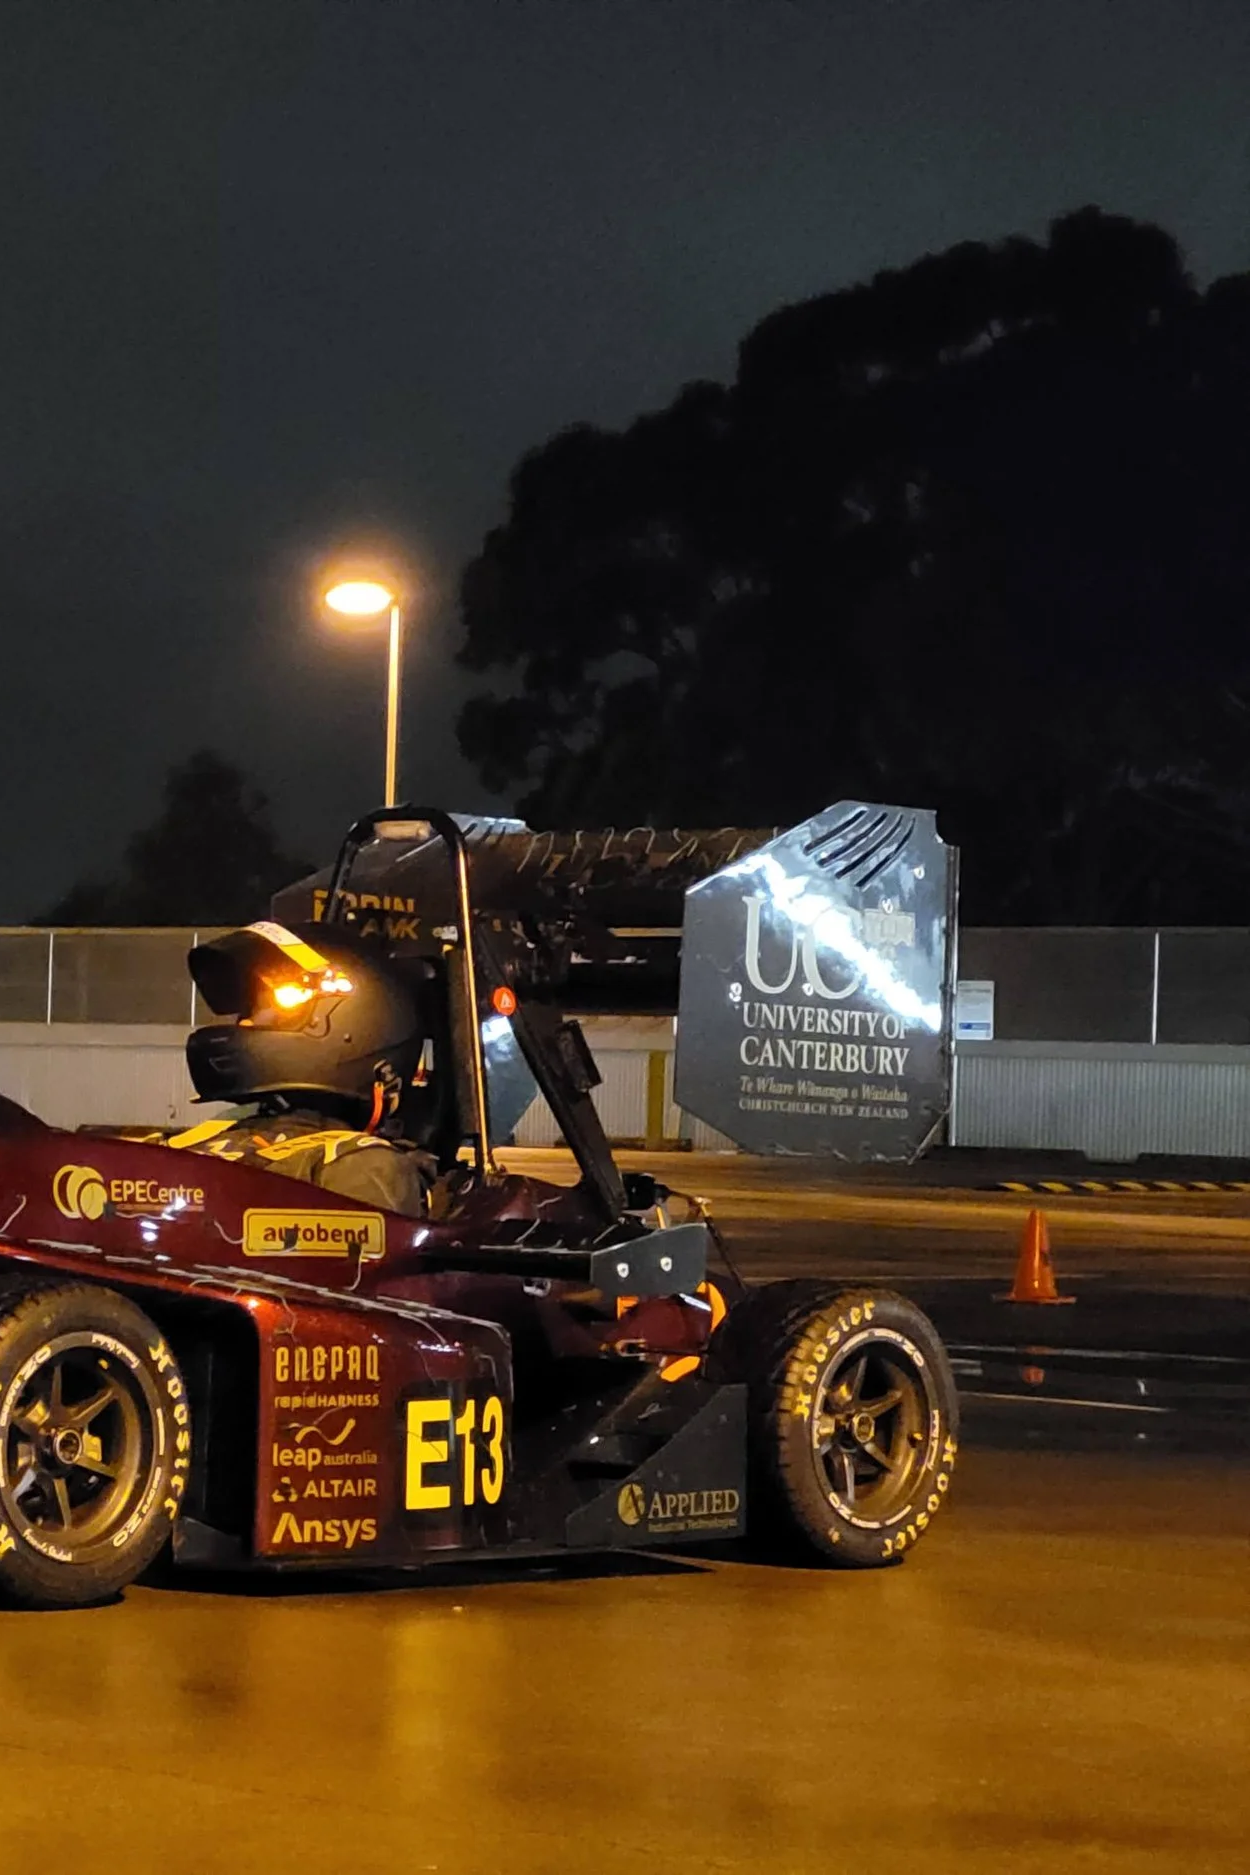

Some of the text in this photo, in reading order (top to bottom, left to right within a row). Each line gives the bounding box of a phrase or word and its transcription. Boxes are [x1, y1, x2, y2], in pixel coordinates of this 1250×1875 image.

[742, 894, 864, 999] UC
[743, 1001, 879, 1037] UNIVERSITY
[739, 1035, 911, 1076] CANTERBURY
[110, 1174, 205, 1204] EPECentre
[272, 1442, 322, 1473] leap
[405, 1396, 504, 1511] E13
[302, 1479, 378, 1499] ALTAIR
[648, 1488, 740, 1520] APPLIED
[271, 1512, 378, 1549] Ansys
